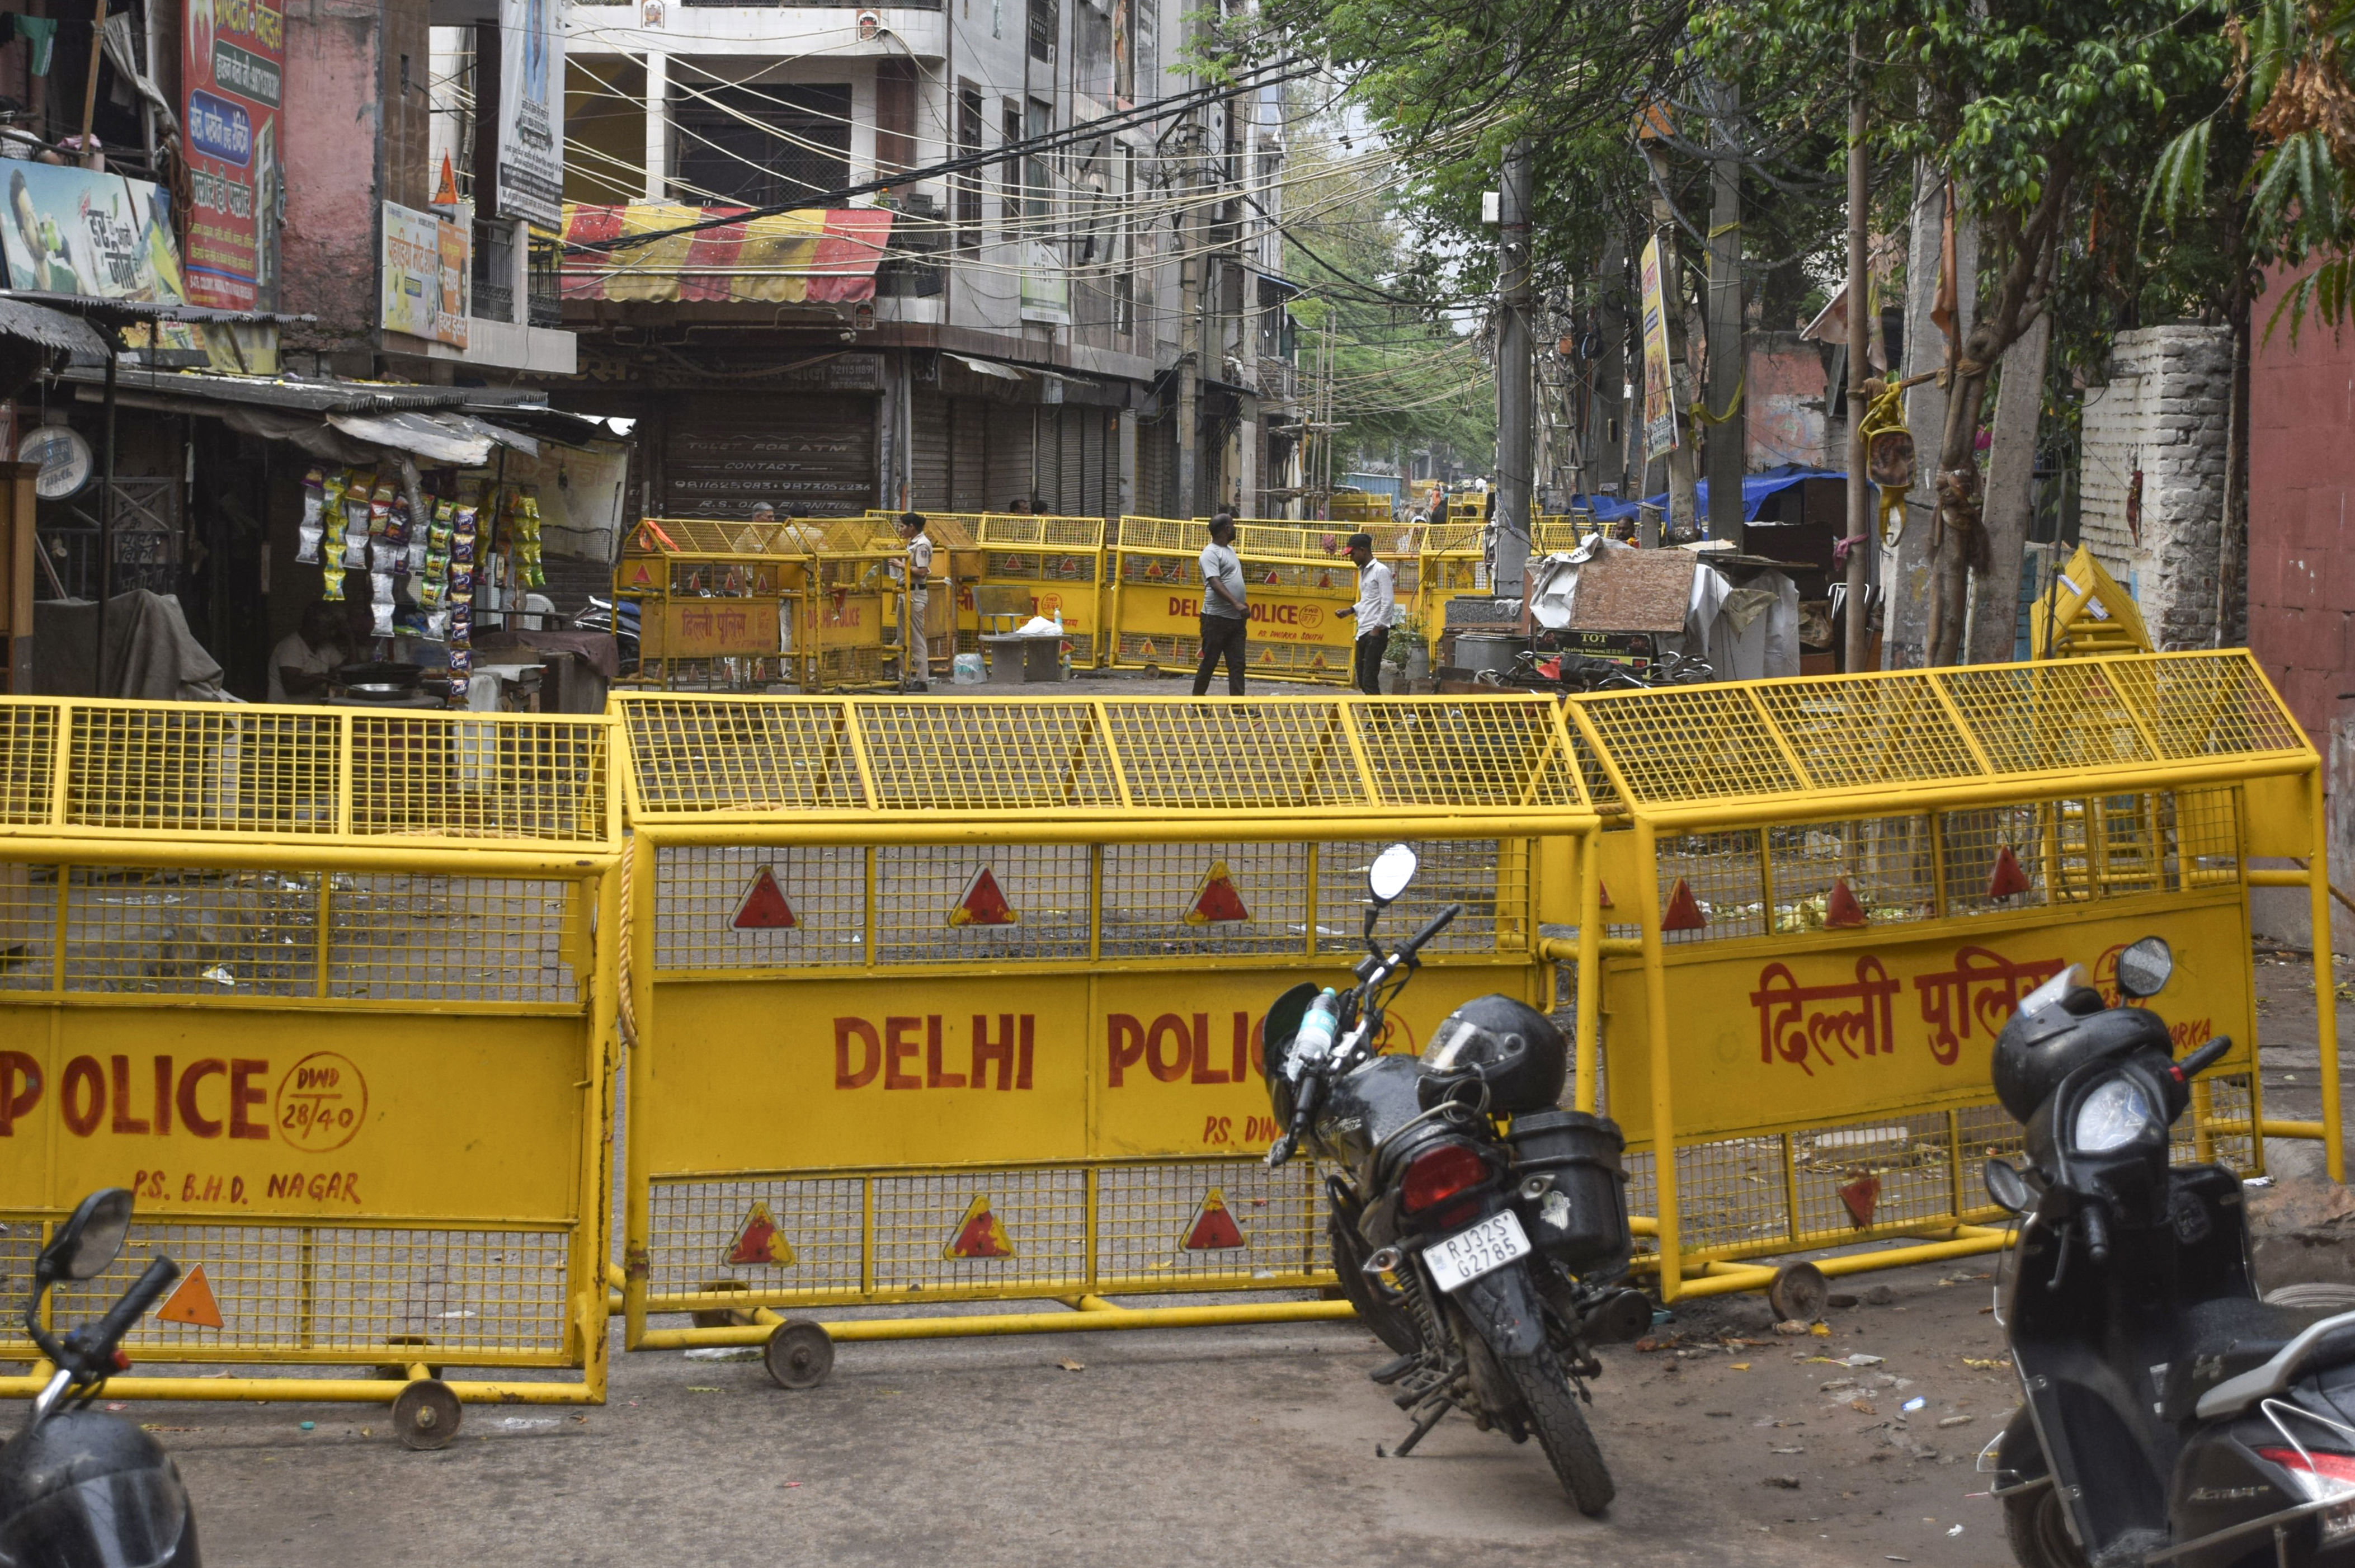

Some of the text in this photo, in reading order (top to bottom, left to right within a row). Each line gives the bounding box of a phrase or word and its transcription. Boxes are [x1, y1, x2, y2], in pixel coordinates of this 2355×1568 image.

[105, 241, 138, 290] जीत
[752, 442, 790, 451] FOR
[799, 444, 849, 453] ATM
[724, 462, 801, 471] CONTACT
[778, 501, 862, 510] FRNITURE
[1169, 597, 1200, 617] DEL
[681, 606, 713, 641] दिल्ली
[1300, 632, 1325, 641] SOUTH
[1580, 633, 1608, 643] TOT
[1749, 954, 1901, 1077] दिल्ली
[833, 1011, 1264, 1090] DELHI POLI
[296, 1067, 340, 1089] DWD
[268, 1171, 362, 1204] NAGAR
[1446, 1216, 1506, 1260] RJ32S
[1457, 1237, 1518, 1278] G2785
